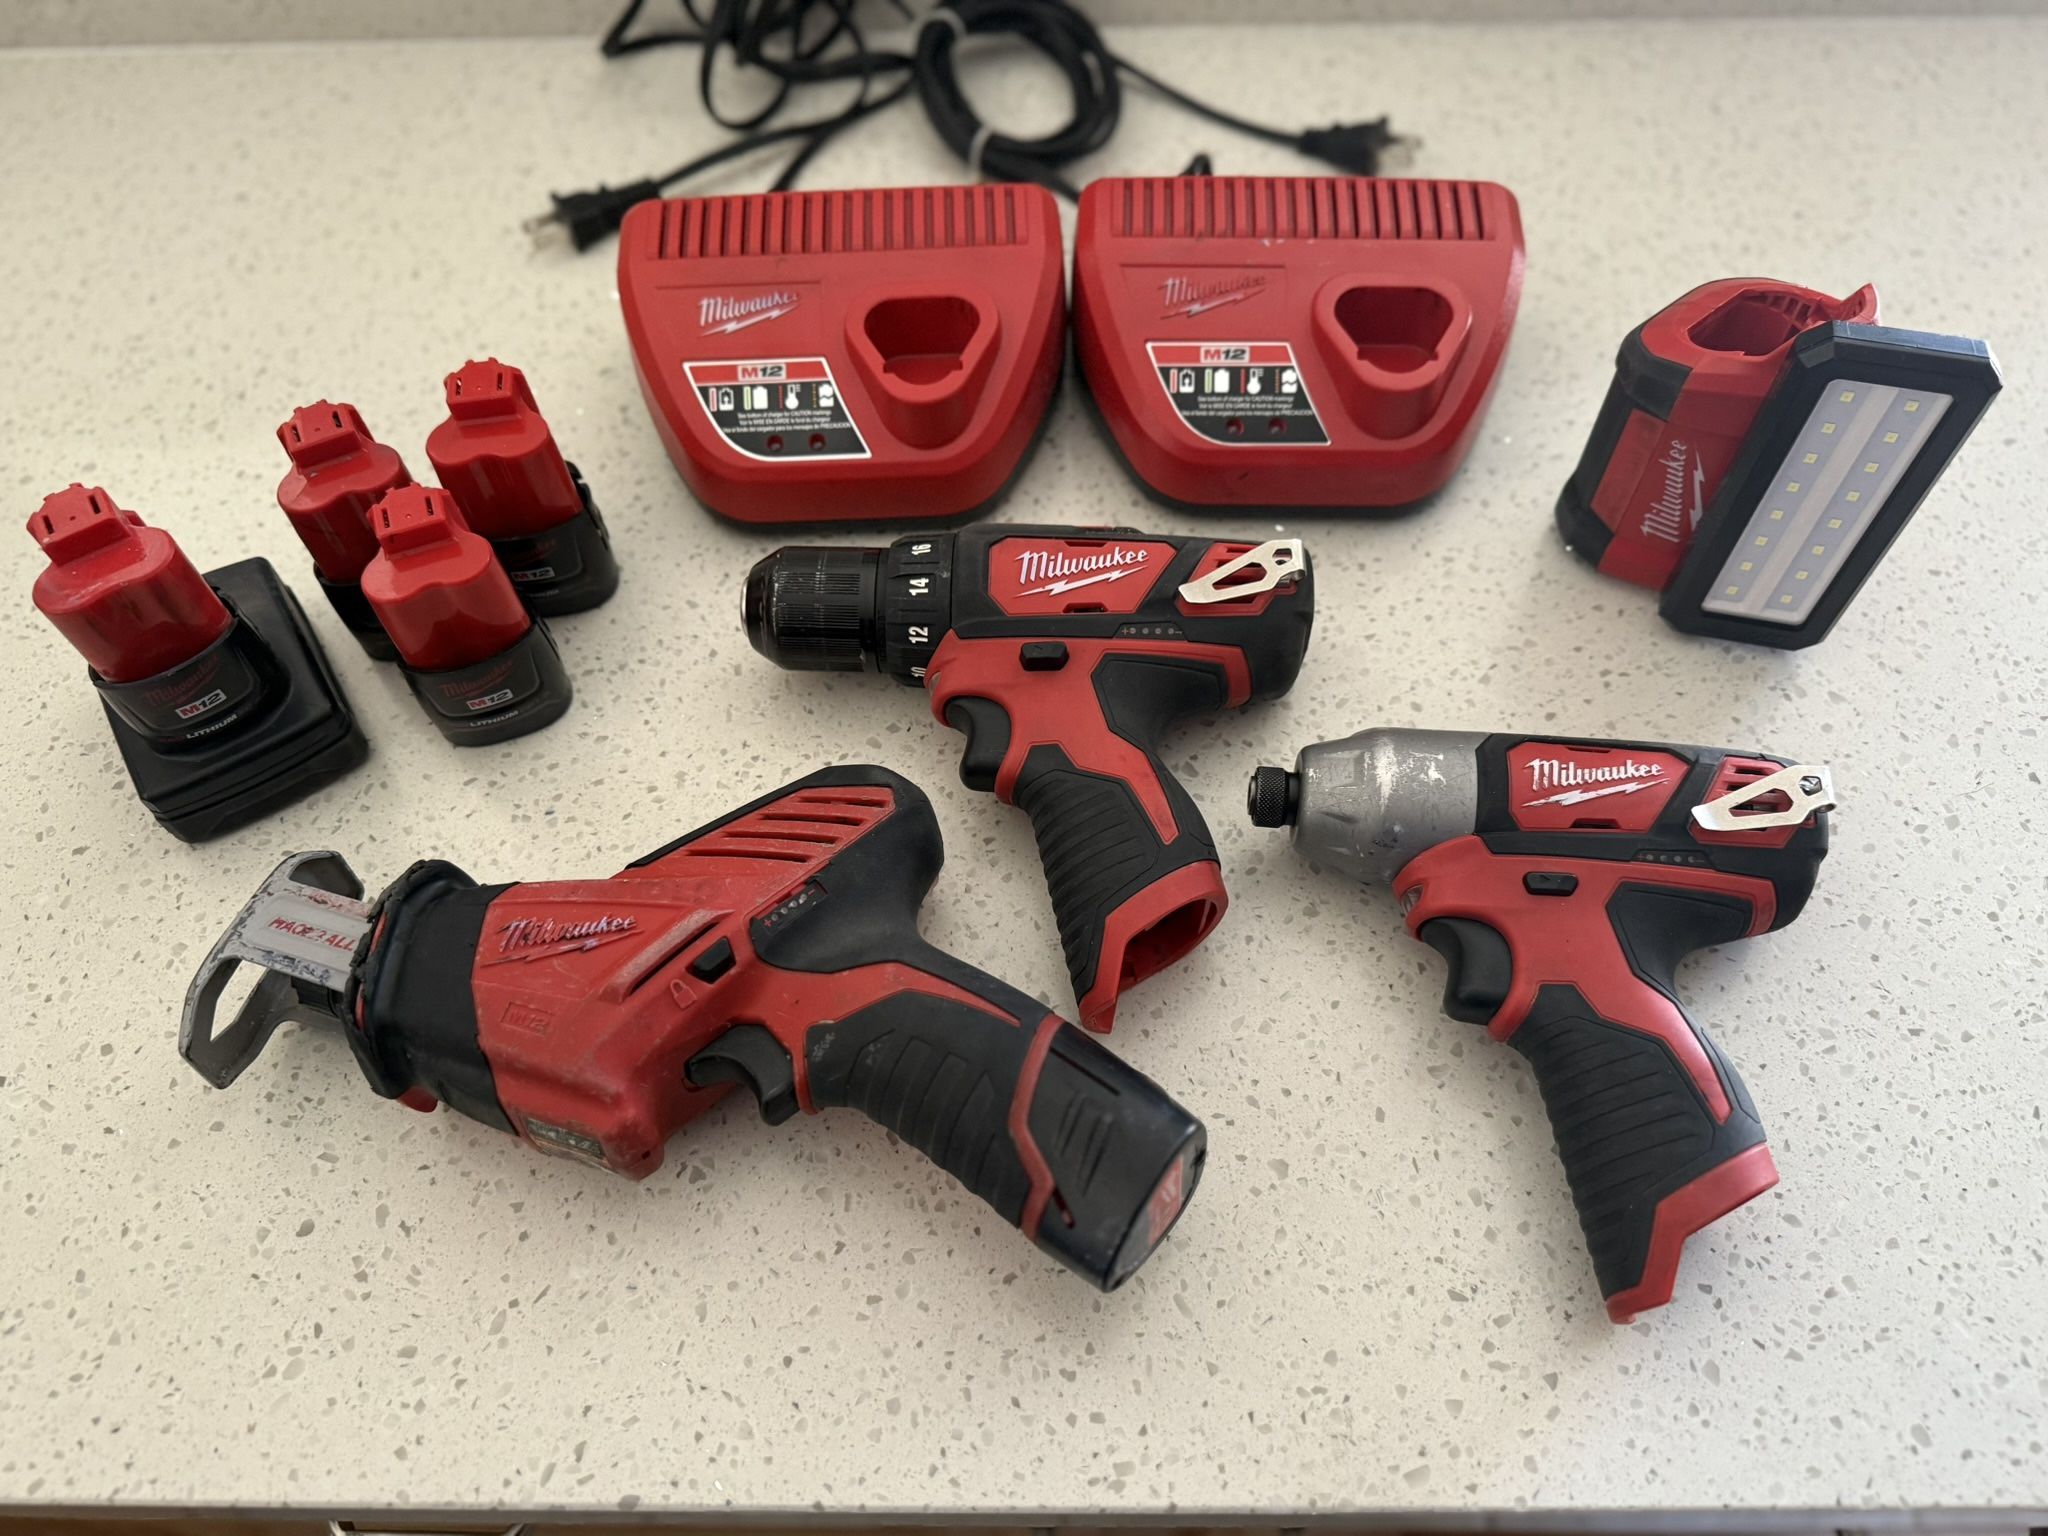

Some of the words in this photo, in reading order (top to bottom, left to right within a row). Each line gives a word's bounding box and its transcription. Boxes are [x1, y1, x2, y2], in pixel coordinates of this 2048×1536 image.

[1204, 348, 1246, 361] M12
[741, 365, 784, 379] M12
[1640, 440, 1687, 542] Milwaukee
[911, 543, 932, 556] 16
[1014, 546, 1149, 585] Milwaukee
[908, 577, 930, 597] 14
[908, 626, 929, 645] 12
[180, 692, 223, 717] M12
[468, 690, 511, 709] M12
[185, 713, 239, 739] LITHIUM
[469, 710, 519, 727] LITHIUM
[1523, 758, 1665, 792] Milwaukee
[497, 914, 637, 953] Milwaukee
